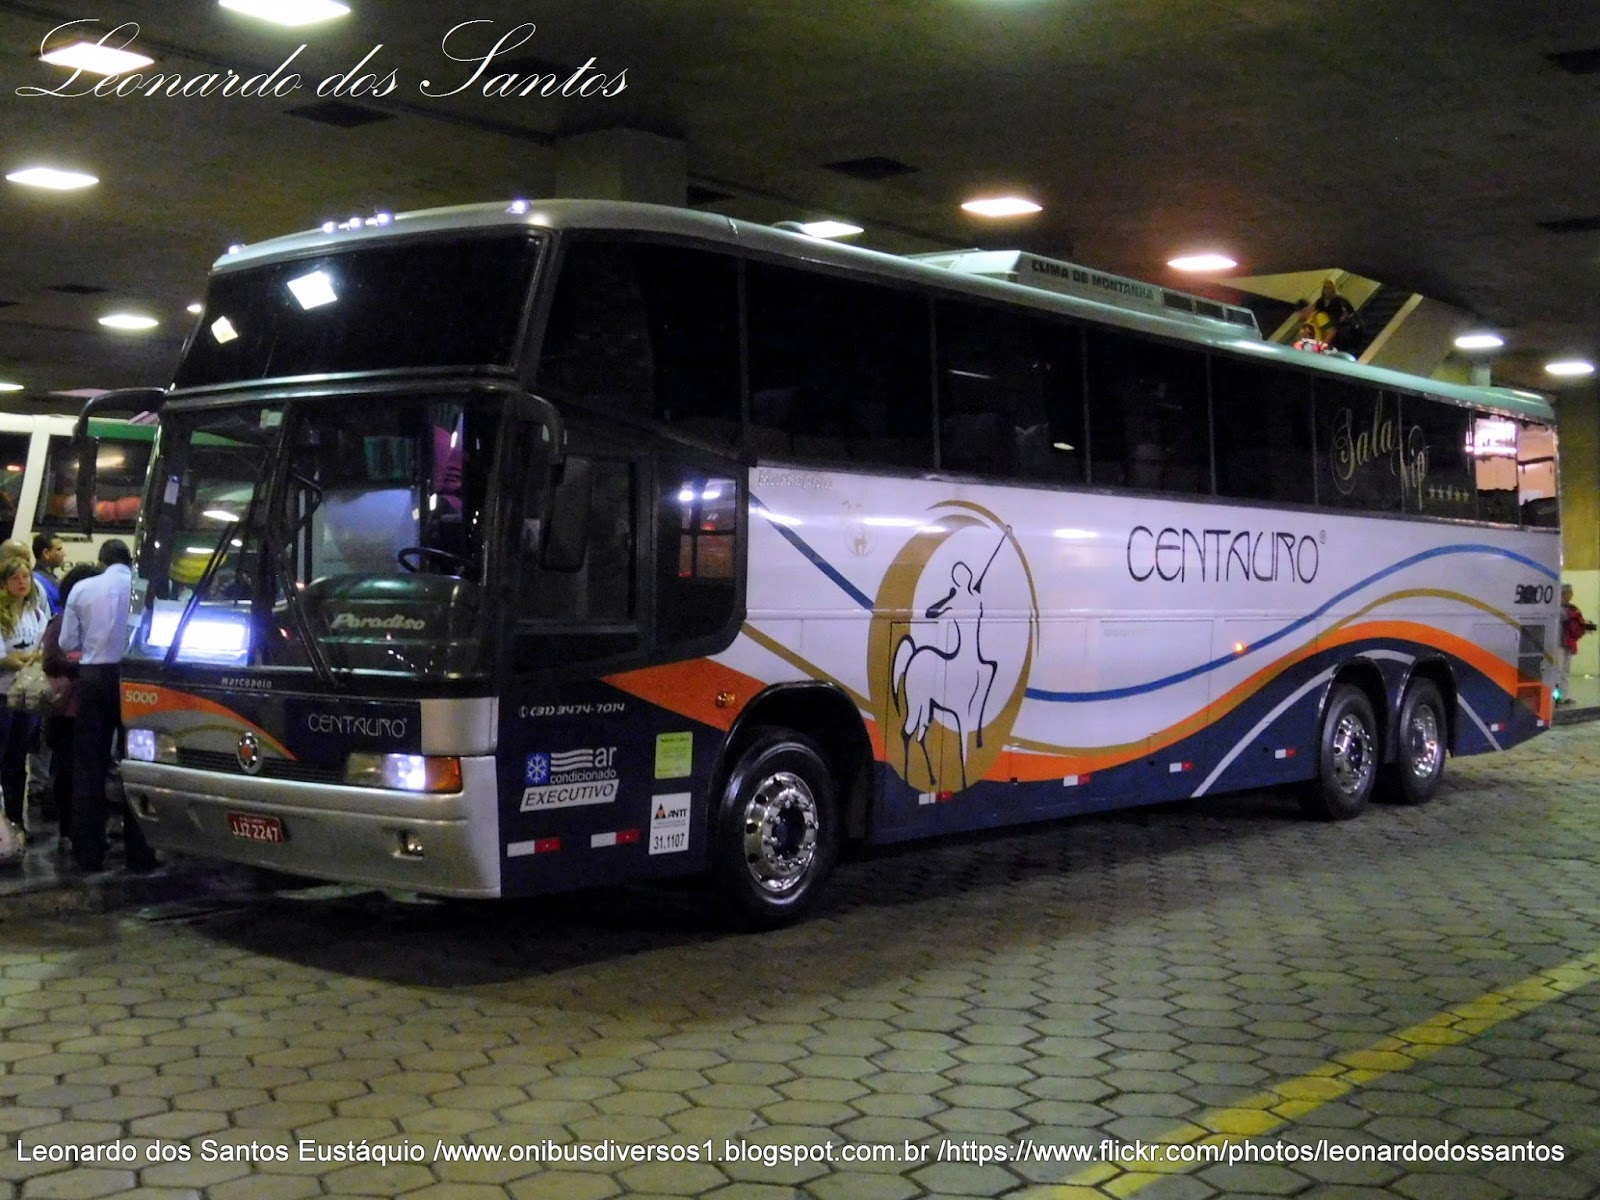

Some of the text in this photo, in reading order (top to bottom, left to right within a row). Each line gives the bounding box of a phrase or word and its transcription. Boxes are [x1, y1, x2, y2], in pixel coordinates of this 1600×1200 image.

[1032, 258, 1155, 301] CLIMA DE MONTANHA
[1330, 390, 1396, 495] Sala
[1126, 525, 1319, 584] CENTAURO
[330, 612, 426, 631] Paradiso
[220, 676, 273, 689] Marcopolo
[124, 691, 159, 705] 5000
[307, 712, 406, 739] CENTAURO
[594, 746, 617, 769] ar
[550, 768, 617, 785] condicionado
[525, 783, 615, 807] EXECUTIVO
[654, 833, 685, 851] 31.1107
